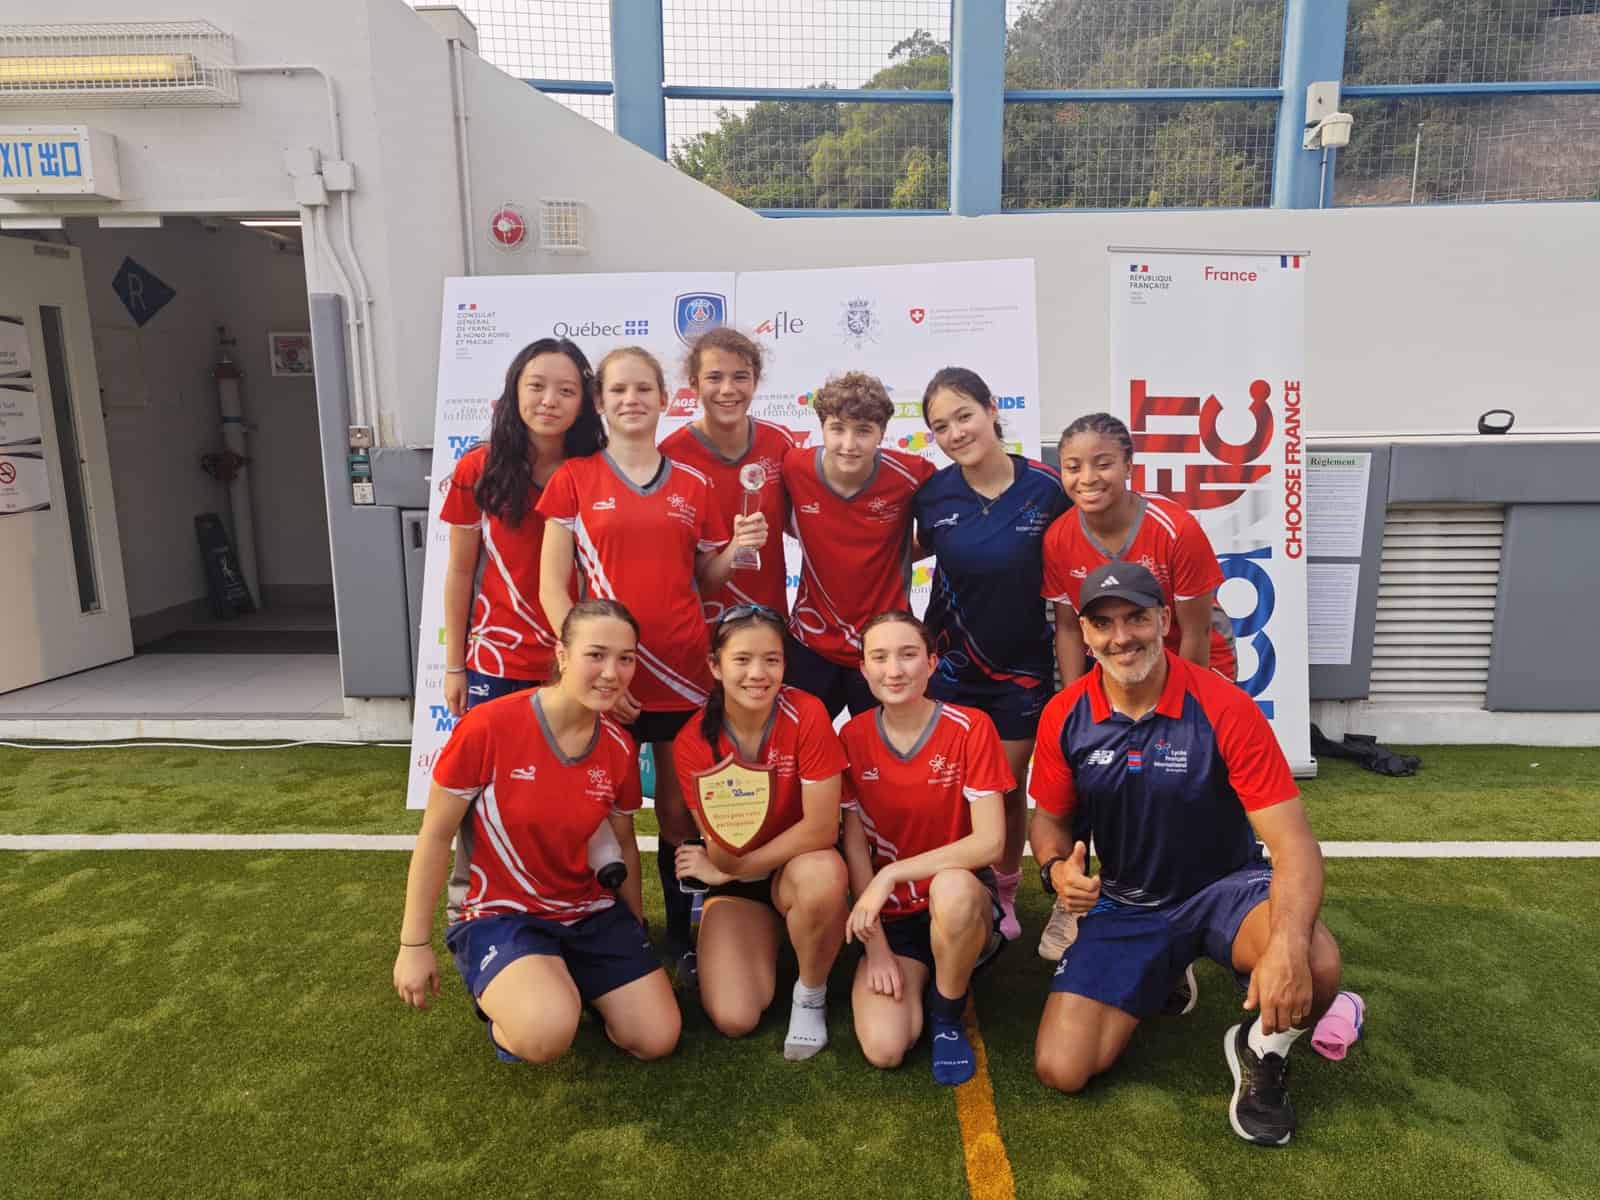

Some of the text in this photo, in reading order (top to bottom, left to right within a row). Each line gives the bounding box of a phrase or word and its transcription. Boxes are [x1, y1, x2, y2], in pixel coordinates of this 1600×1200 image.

[0, 142, 32, 177] XIT
[38, 142, 82, 177] 出口
[1204, 265, 1257, 282] France
[553, 321, 622, 337] Québec
[1285, 380, 1303, 560] CHOOSE FRANCE
